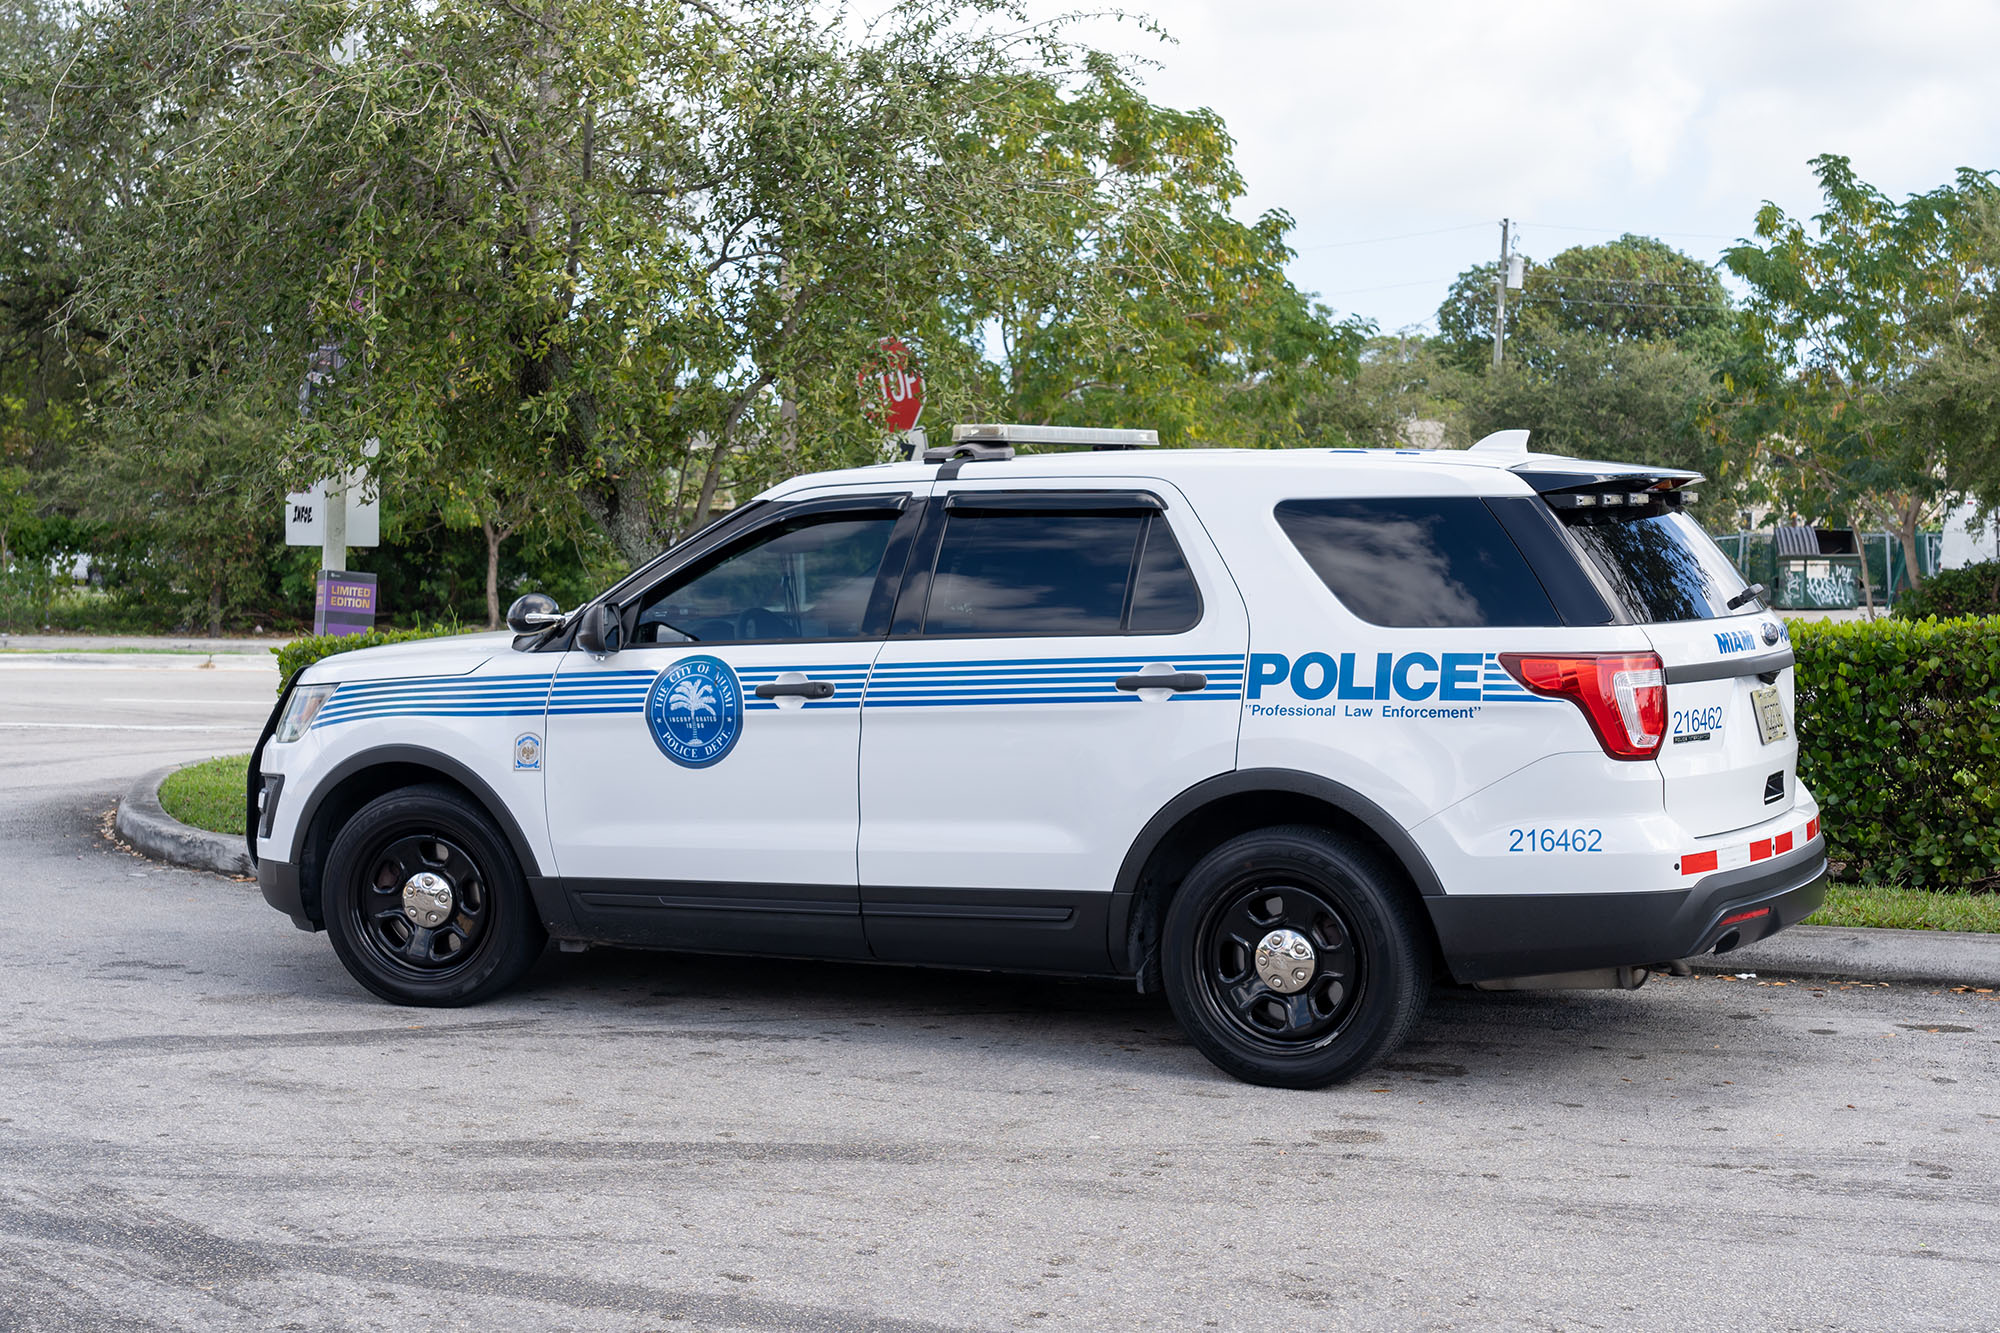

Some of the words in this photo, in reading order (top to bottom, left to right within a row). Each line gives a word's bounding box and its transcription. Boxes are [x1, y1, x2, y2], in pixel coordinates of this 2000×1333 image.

[863, 366, 917, 408] TOP
[330, 596, 370, 609] EDITION
[331, 585, 371, 598] LIMITED
[1713, 630, 1756, 654] MIAMI
[654, 686, 670, 709] THE
[669, 665, 693, 683] CITY
[697, 664, 710, 674] OF
[714, 671, 734, 708] MIAMI
[1246, 652, 1484, 701] POLICE
[1344, 705, 1373, 717] Law
[1673, 706, 1723, 734] 216462
[662, 731, 698, 758] POLICE
[704, 730, 731, 756] DEPT.
[1508, 828, 1603, 852] 216462
